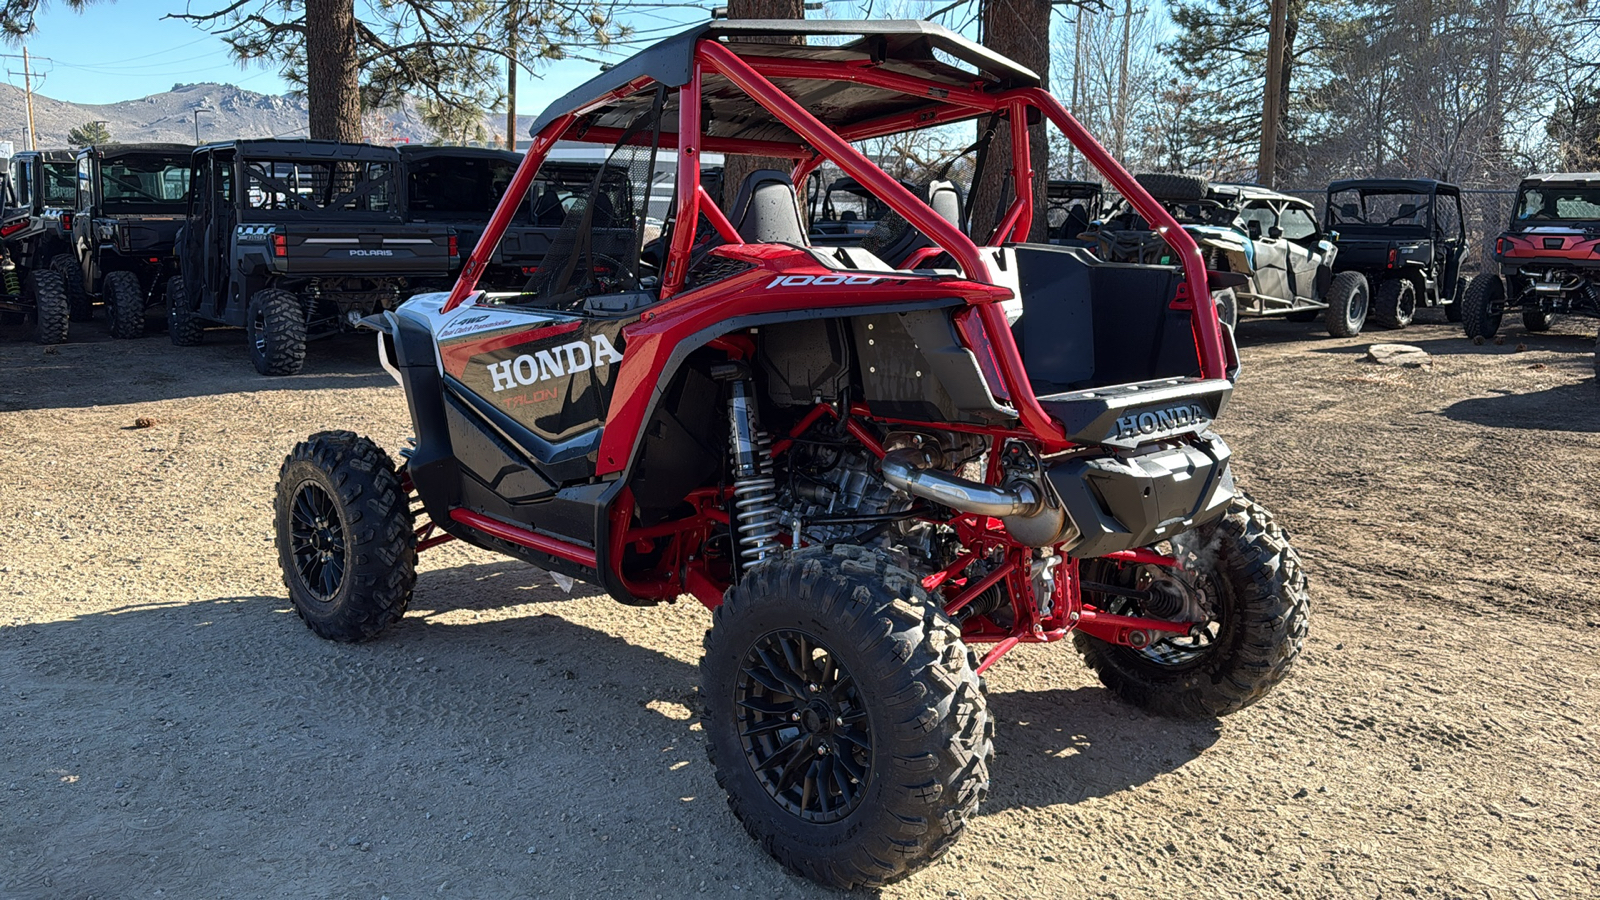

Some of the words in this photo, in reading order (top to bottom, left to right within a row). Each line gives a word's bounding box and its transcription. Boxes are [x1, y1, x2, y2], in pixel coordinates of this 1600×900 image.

[454, 325, 472, 335] Clutch
[487, 334, 623, 392] HONDA
[502, 387, 558, 409] TALON
[1116, 405, 1207, 440] HONDA
